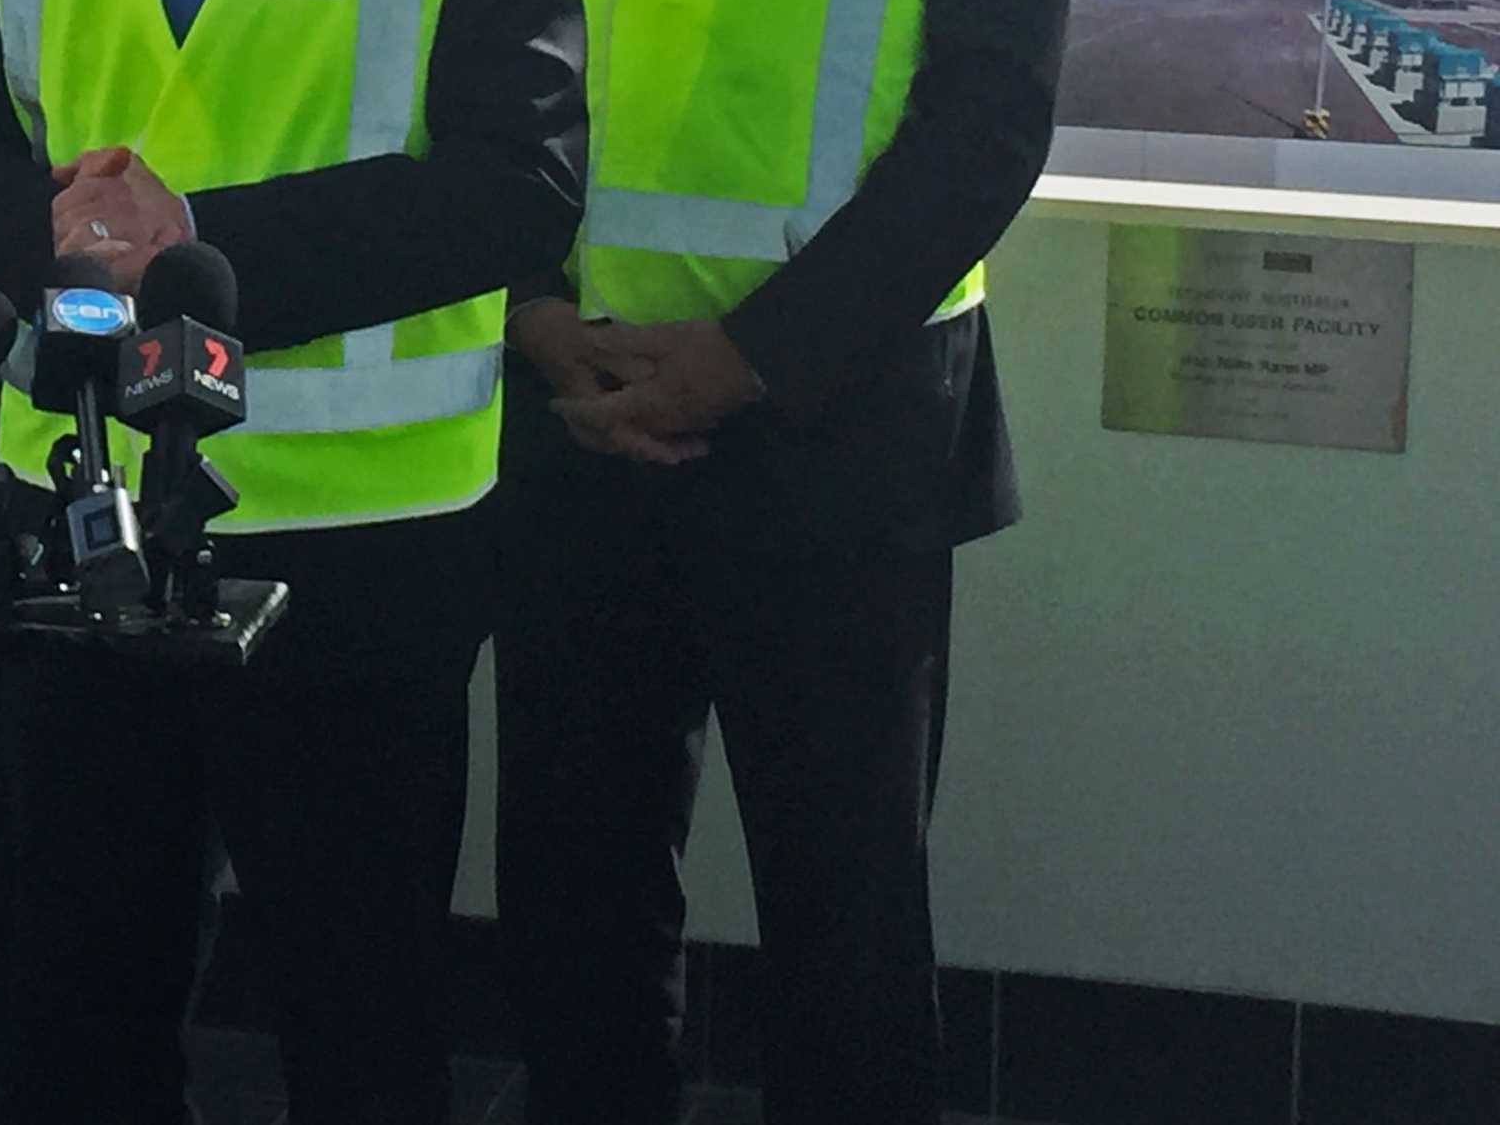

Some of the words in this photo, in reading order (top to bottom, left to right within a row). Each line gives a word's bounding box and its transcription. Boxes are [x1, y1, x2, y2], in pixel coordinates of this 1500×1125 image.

[1133, 305, 1224, 326] COMMON
[1230, 313, 1284, 330] USER
[1291, 316, 1381, 337] FACILITY
[125, 368, 174, 398] NEWS
[193, 369, 241, 401] NEWS
